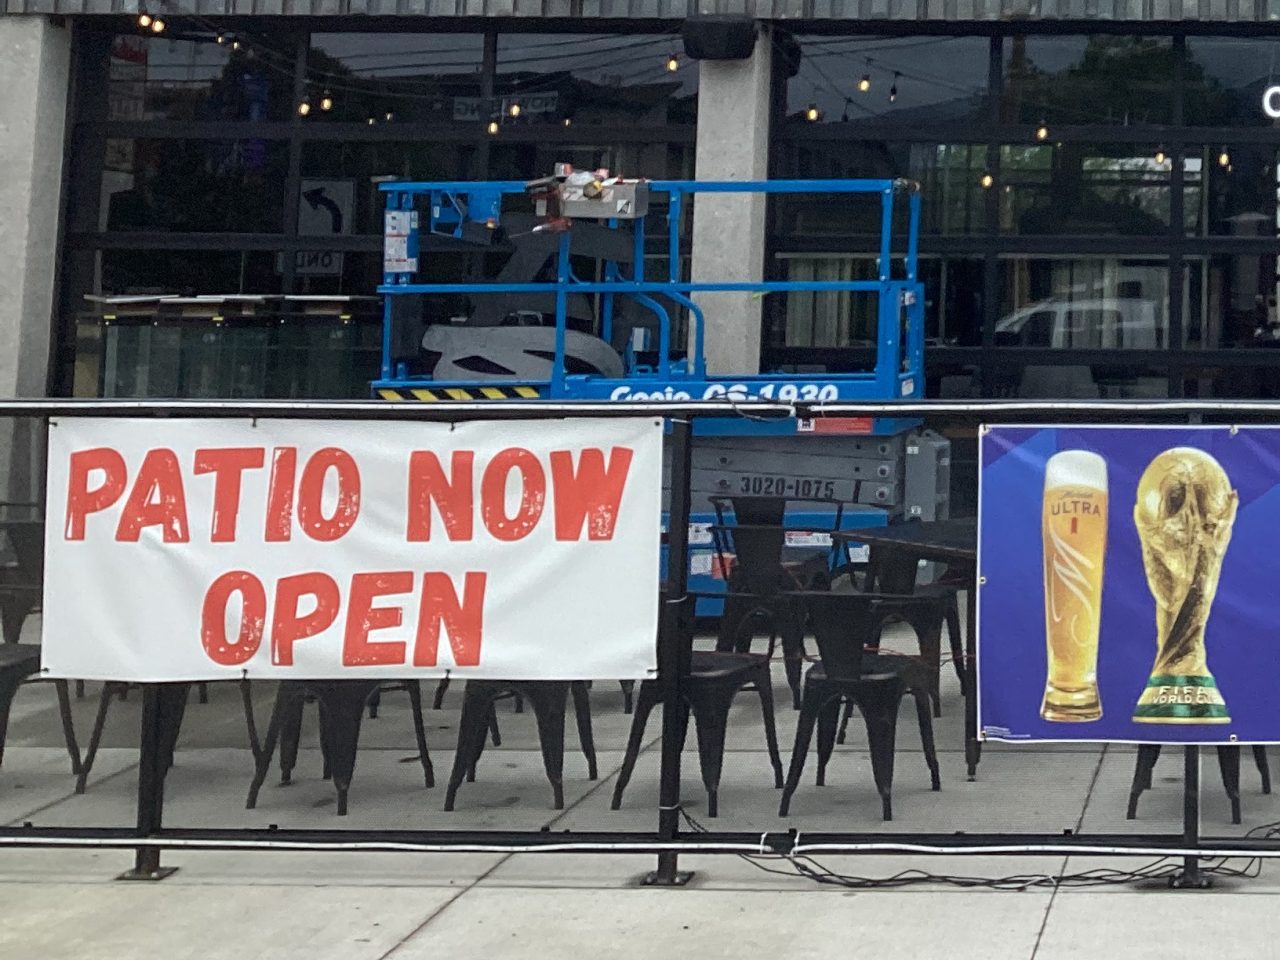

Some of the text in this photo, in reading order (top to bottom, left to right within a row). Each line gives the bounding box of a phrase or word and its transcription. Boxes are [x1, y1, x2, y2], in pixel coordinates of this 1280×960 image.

[64, 446, 634, 543] PATIO NOW
[740, 476, 836, 499] 3020-1075
[1051, 500, 1101, 517] ULTRA
[201, 570, 487, 667] OPEN
[1159, 685, 1207, 696] FIFA
